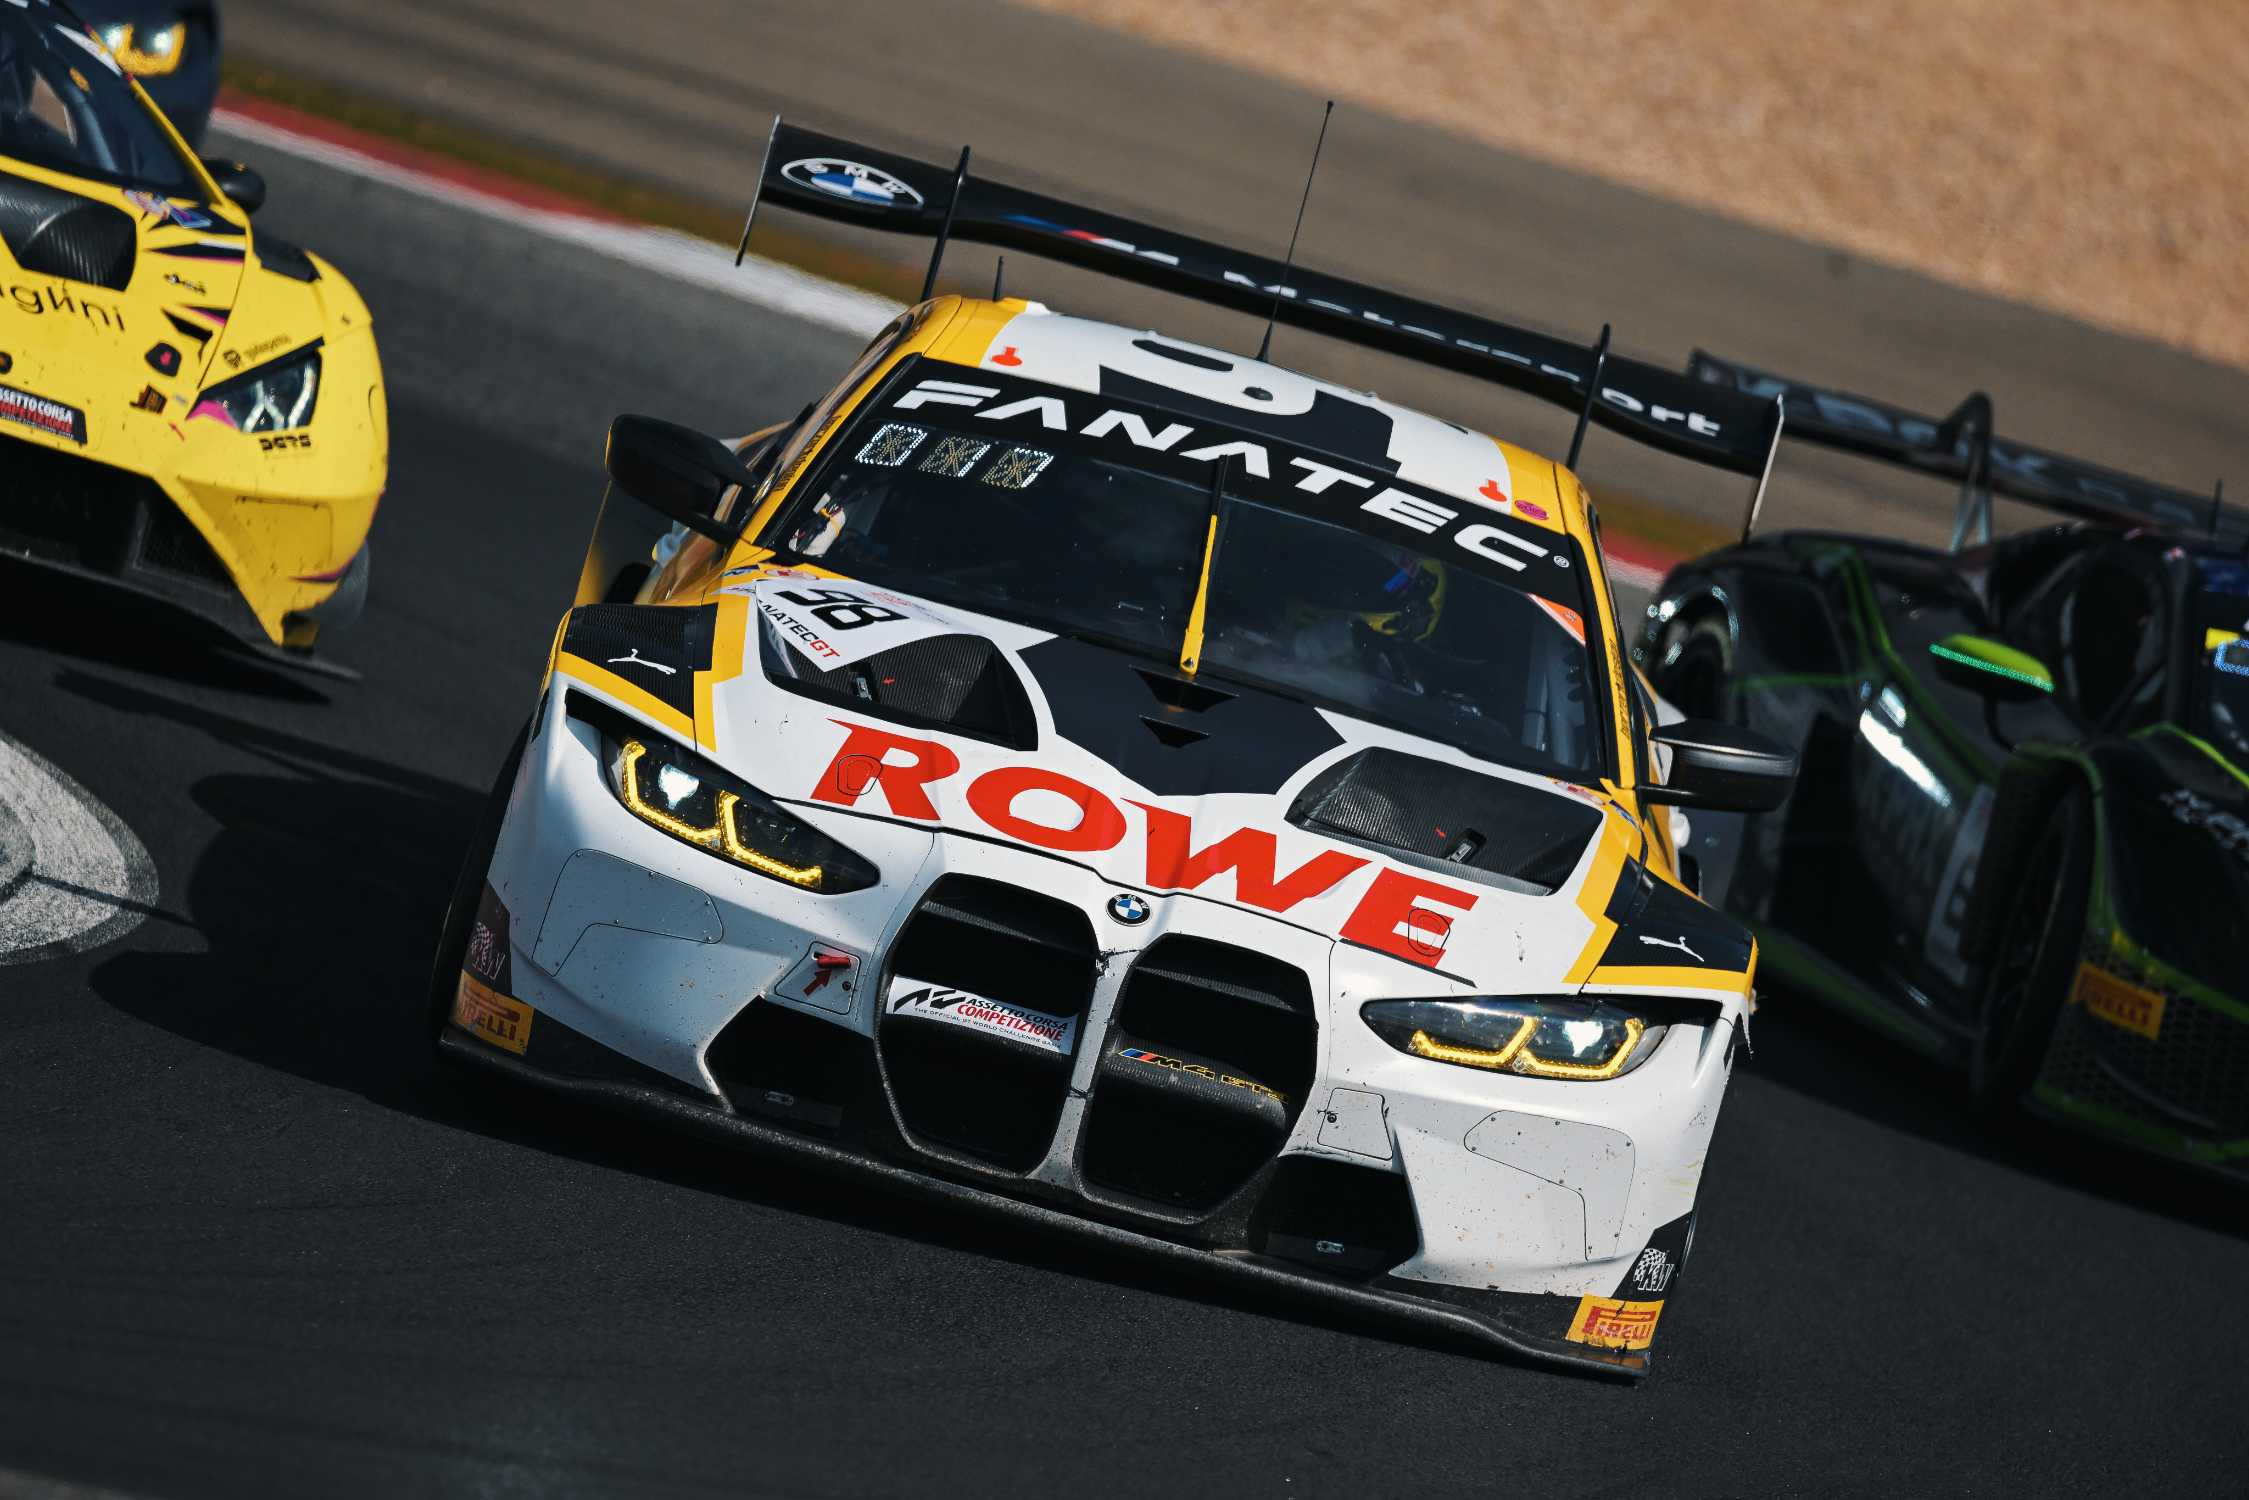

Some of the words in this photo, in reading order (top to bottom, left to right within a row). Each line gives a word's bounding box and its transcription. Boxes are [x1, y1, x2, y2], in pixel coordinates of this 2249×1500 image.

[892, 379, 1549, 573] FANATEC
[773, 588, 911, 631] 98
[810, 717, 1479, 969] ROWE
[957, 1004, 1066, 1041] COMPETIZIONE
[966, 997, 1025, 1018] ASSETTO
[1025, 1013, 1068, 1031] CORSA
